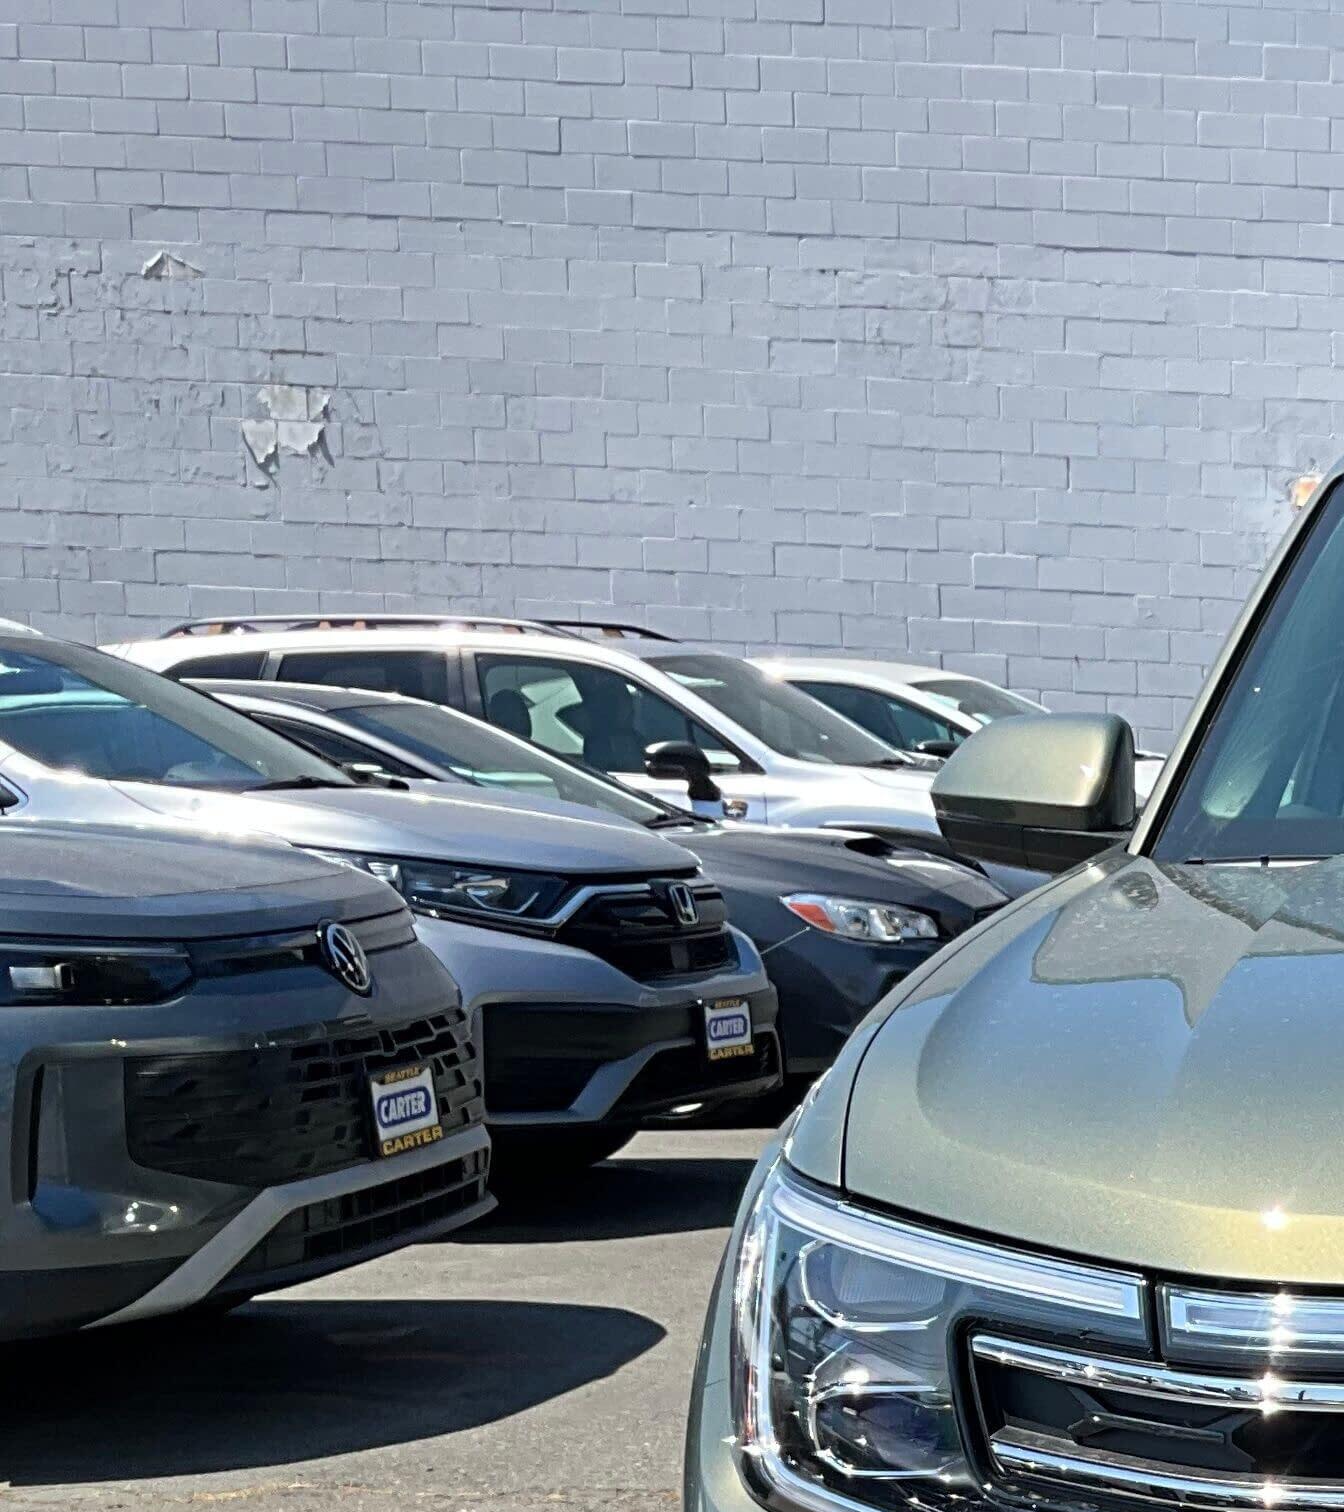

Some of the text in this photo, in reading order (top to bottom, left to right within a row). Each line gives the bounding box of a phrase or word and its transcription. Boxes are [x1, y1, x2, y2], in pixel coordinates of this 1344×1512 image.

[710, 1017, 745, 1038] CARTER
[380, 1090, 426, 1123] CARTER
[383, 1126, 443, 1156] CARTER
